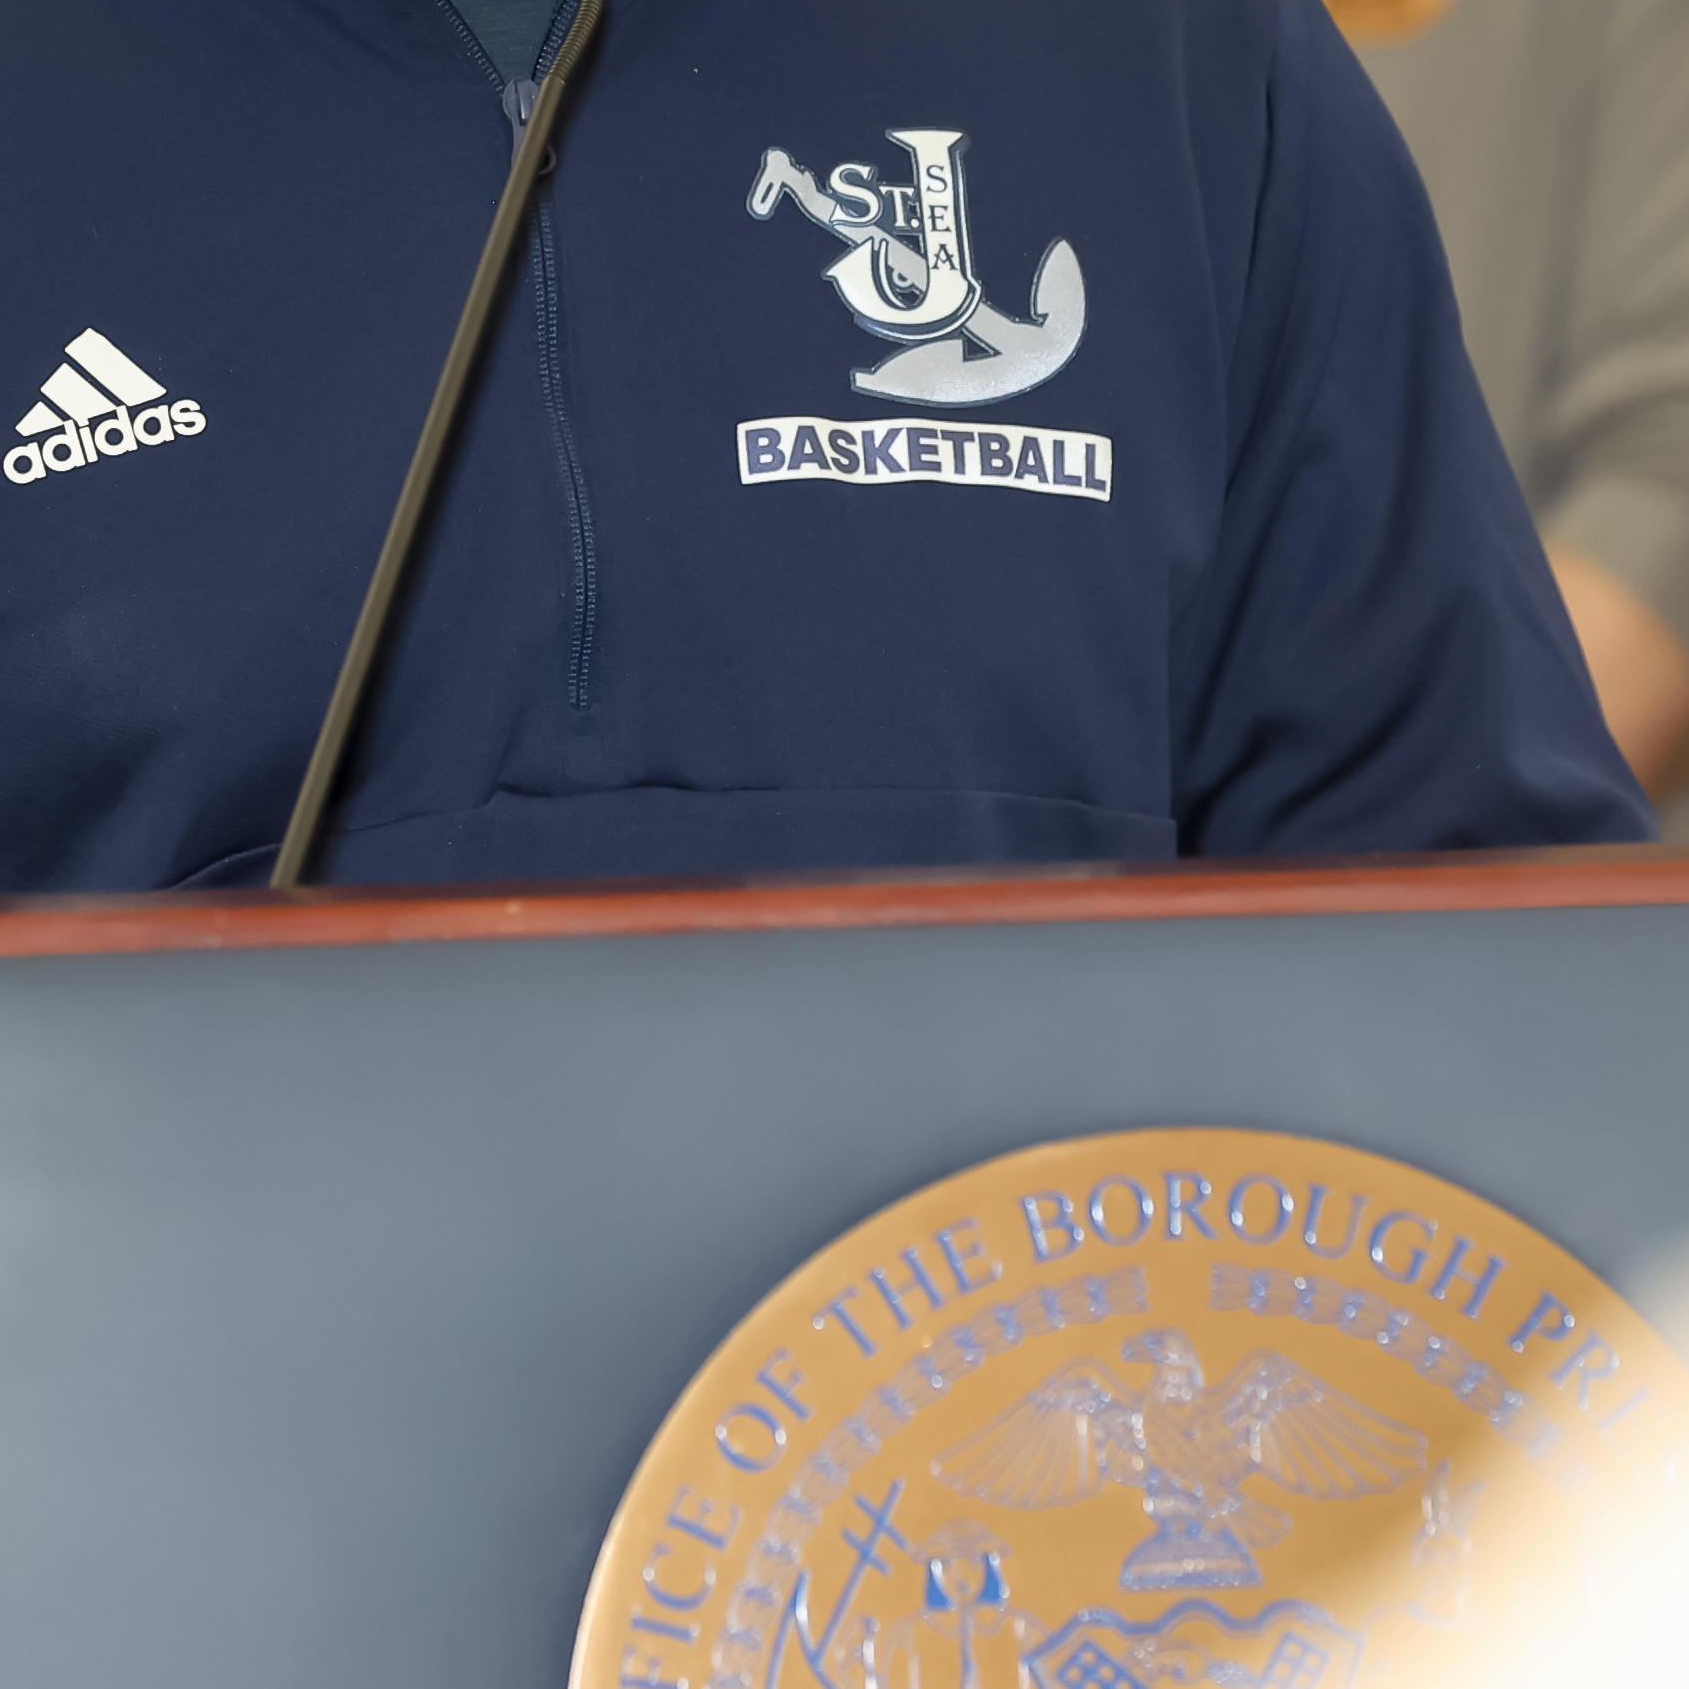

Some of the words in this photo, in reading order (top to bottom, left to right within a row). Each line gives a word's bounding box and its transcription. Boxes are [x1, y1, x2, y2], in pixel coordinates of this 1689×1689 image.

[925, 164, 960, 271] SEA
[2, 398, 207, 485] adidas
[744, 425, 1108, 493] BASKETBALL
[714, 1346, 815, 1474] OF
[812, 1216, 1004, 1359] THE
[1017, 1169, 1508, 1320] BOROUGH
